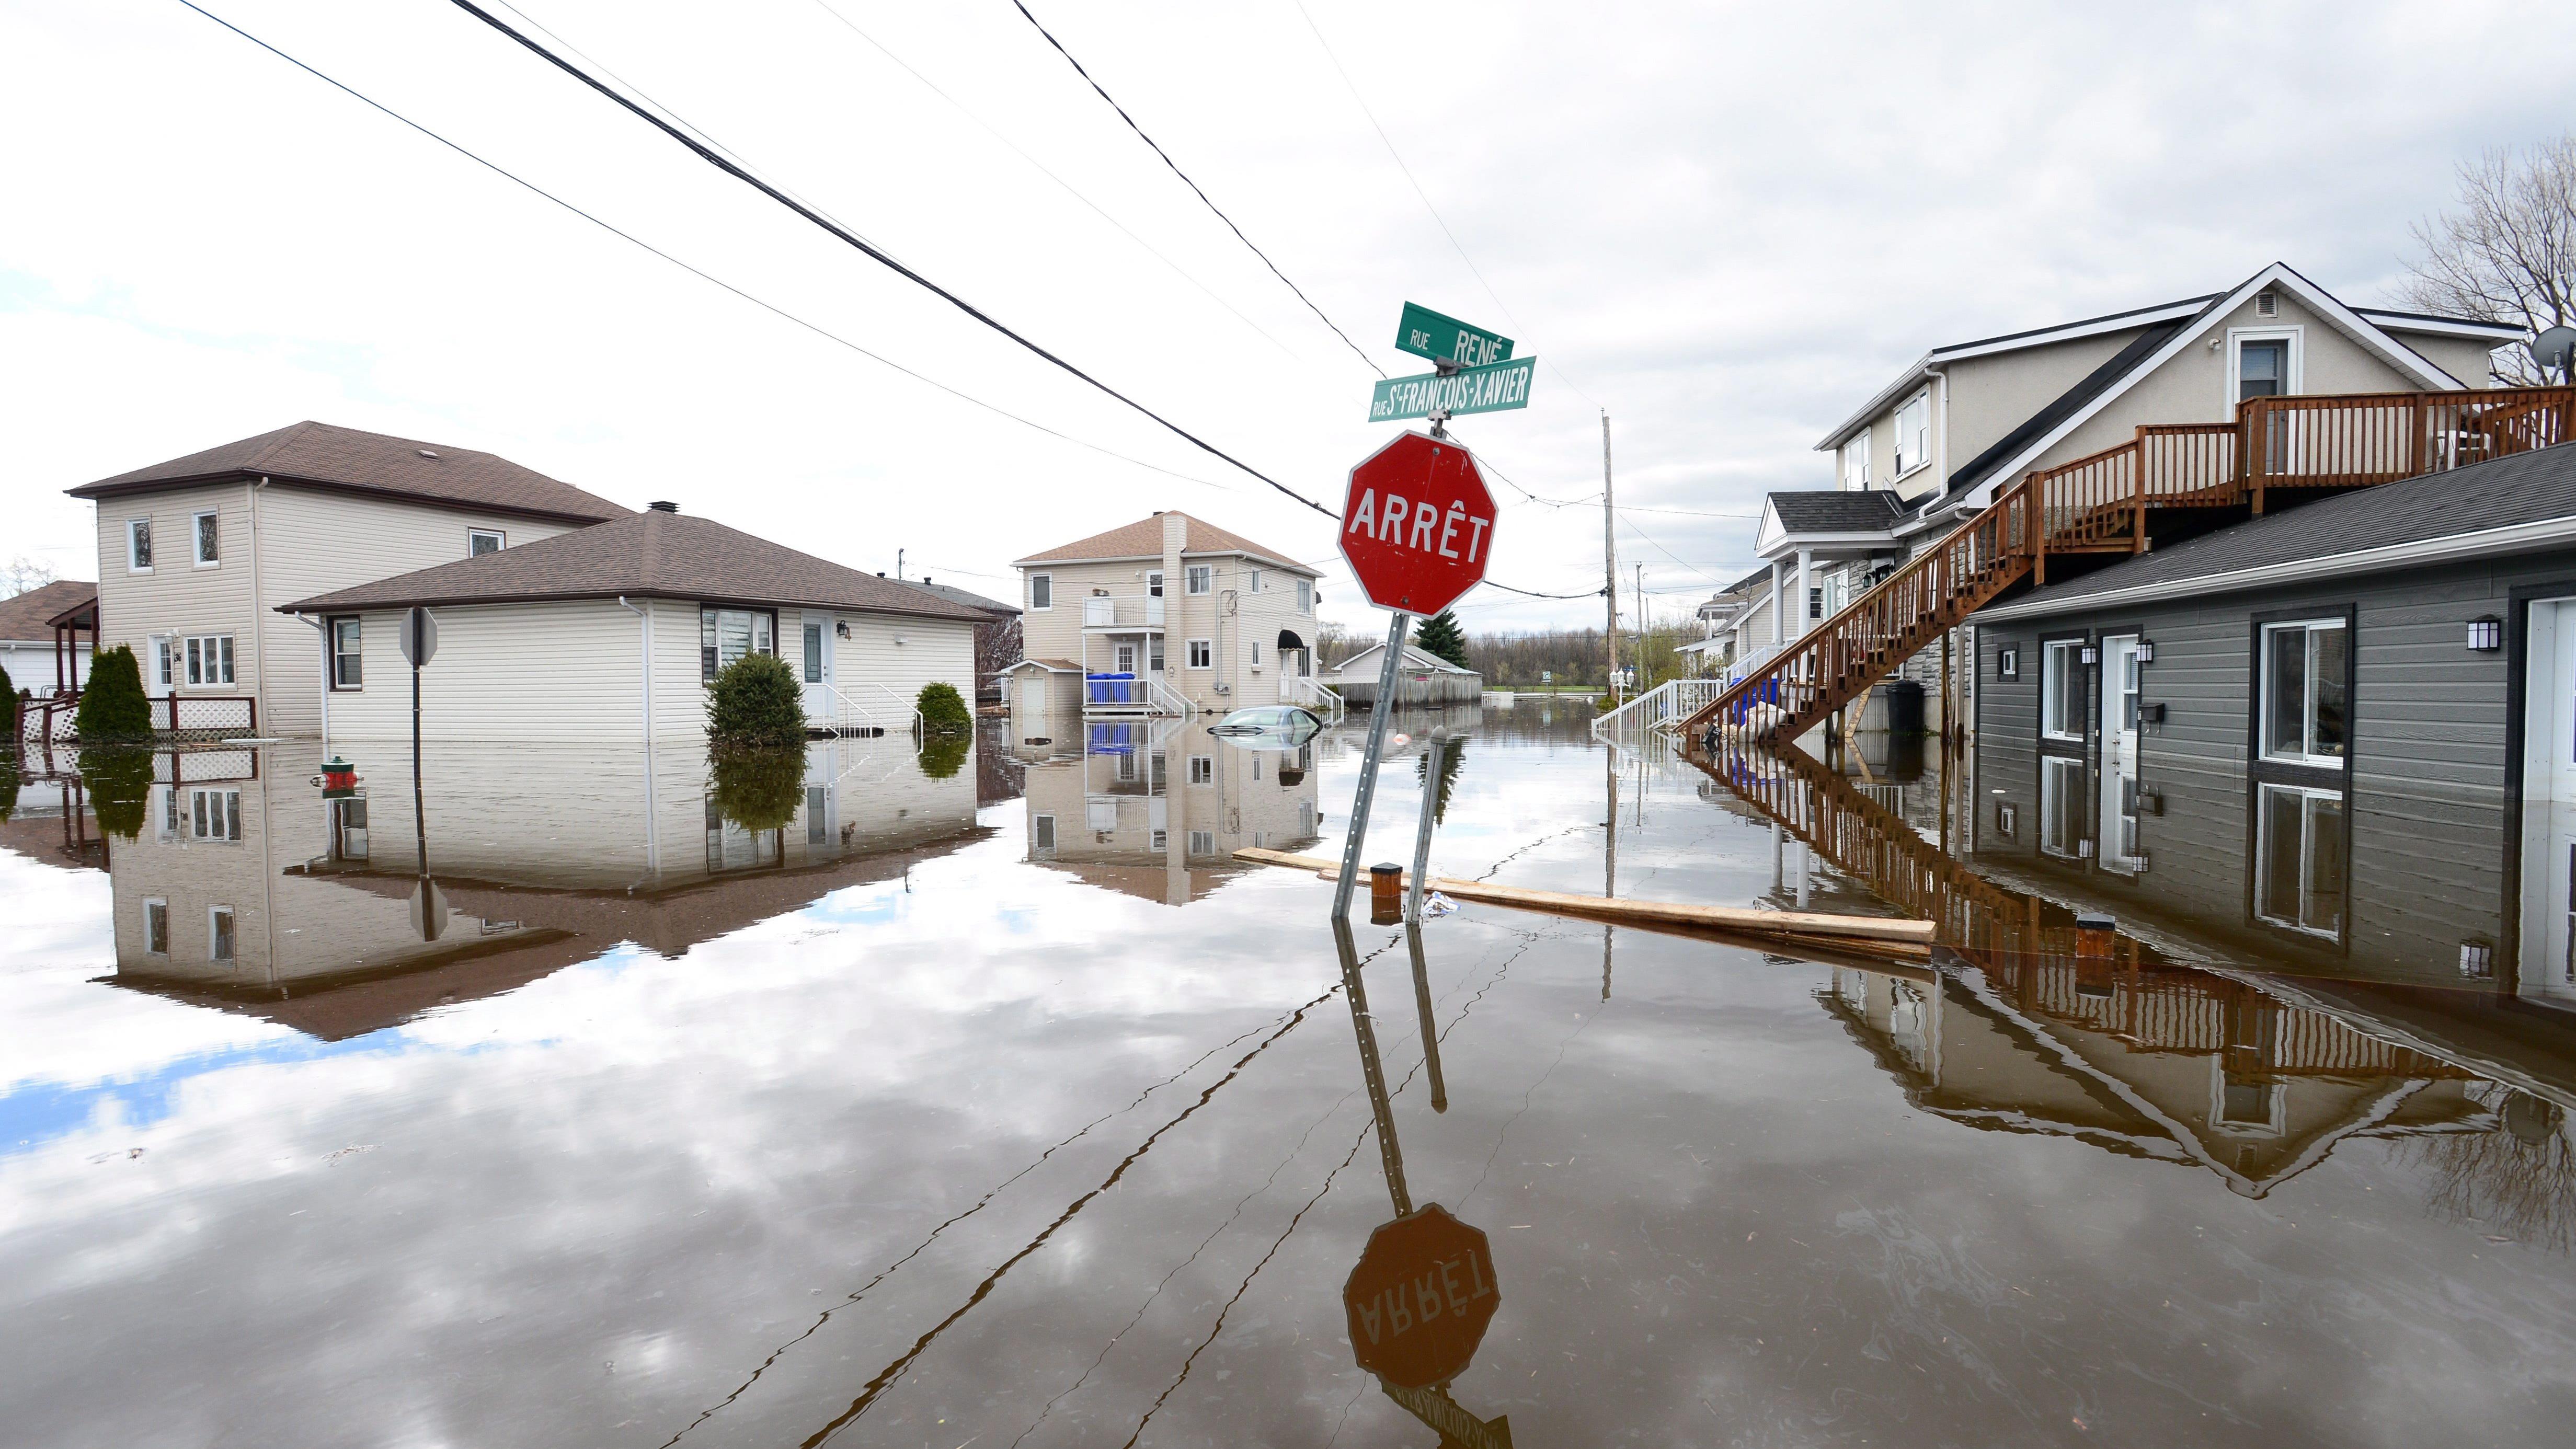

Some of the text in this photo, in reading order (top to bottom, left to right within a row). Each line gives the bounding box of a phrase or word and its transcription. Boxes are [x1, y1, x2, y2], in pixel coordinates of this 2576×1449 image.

[1410, 329, 1502, 366] RUE RENÉ
[1372, 400, 1388, 416] RUE
[1349, 488, 1489, 563] ARRÊT
[845, 627, 852, 641] 4
